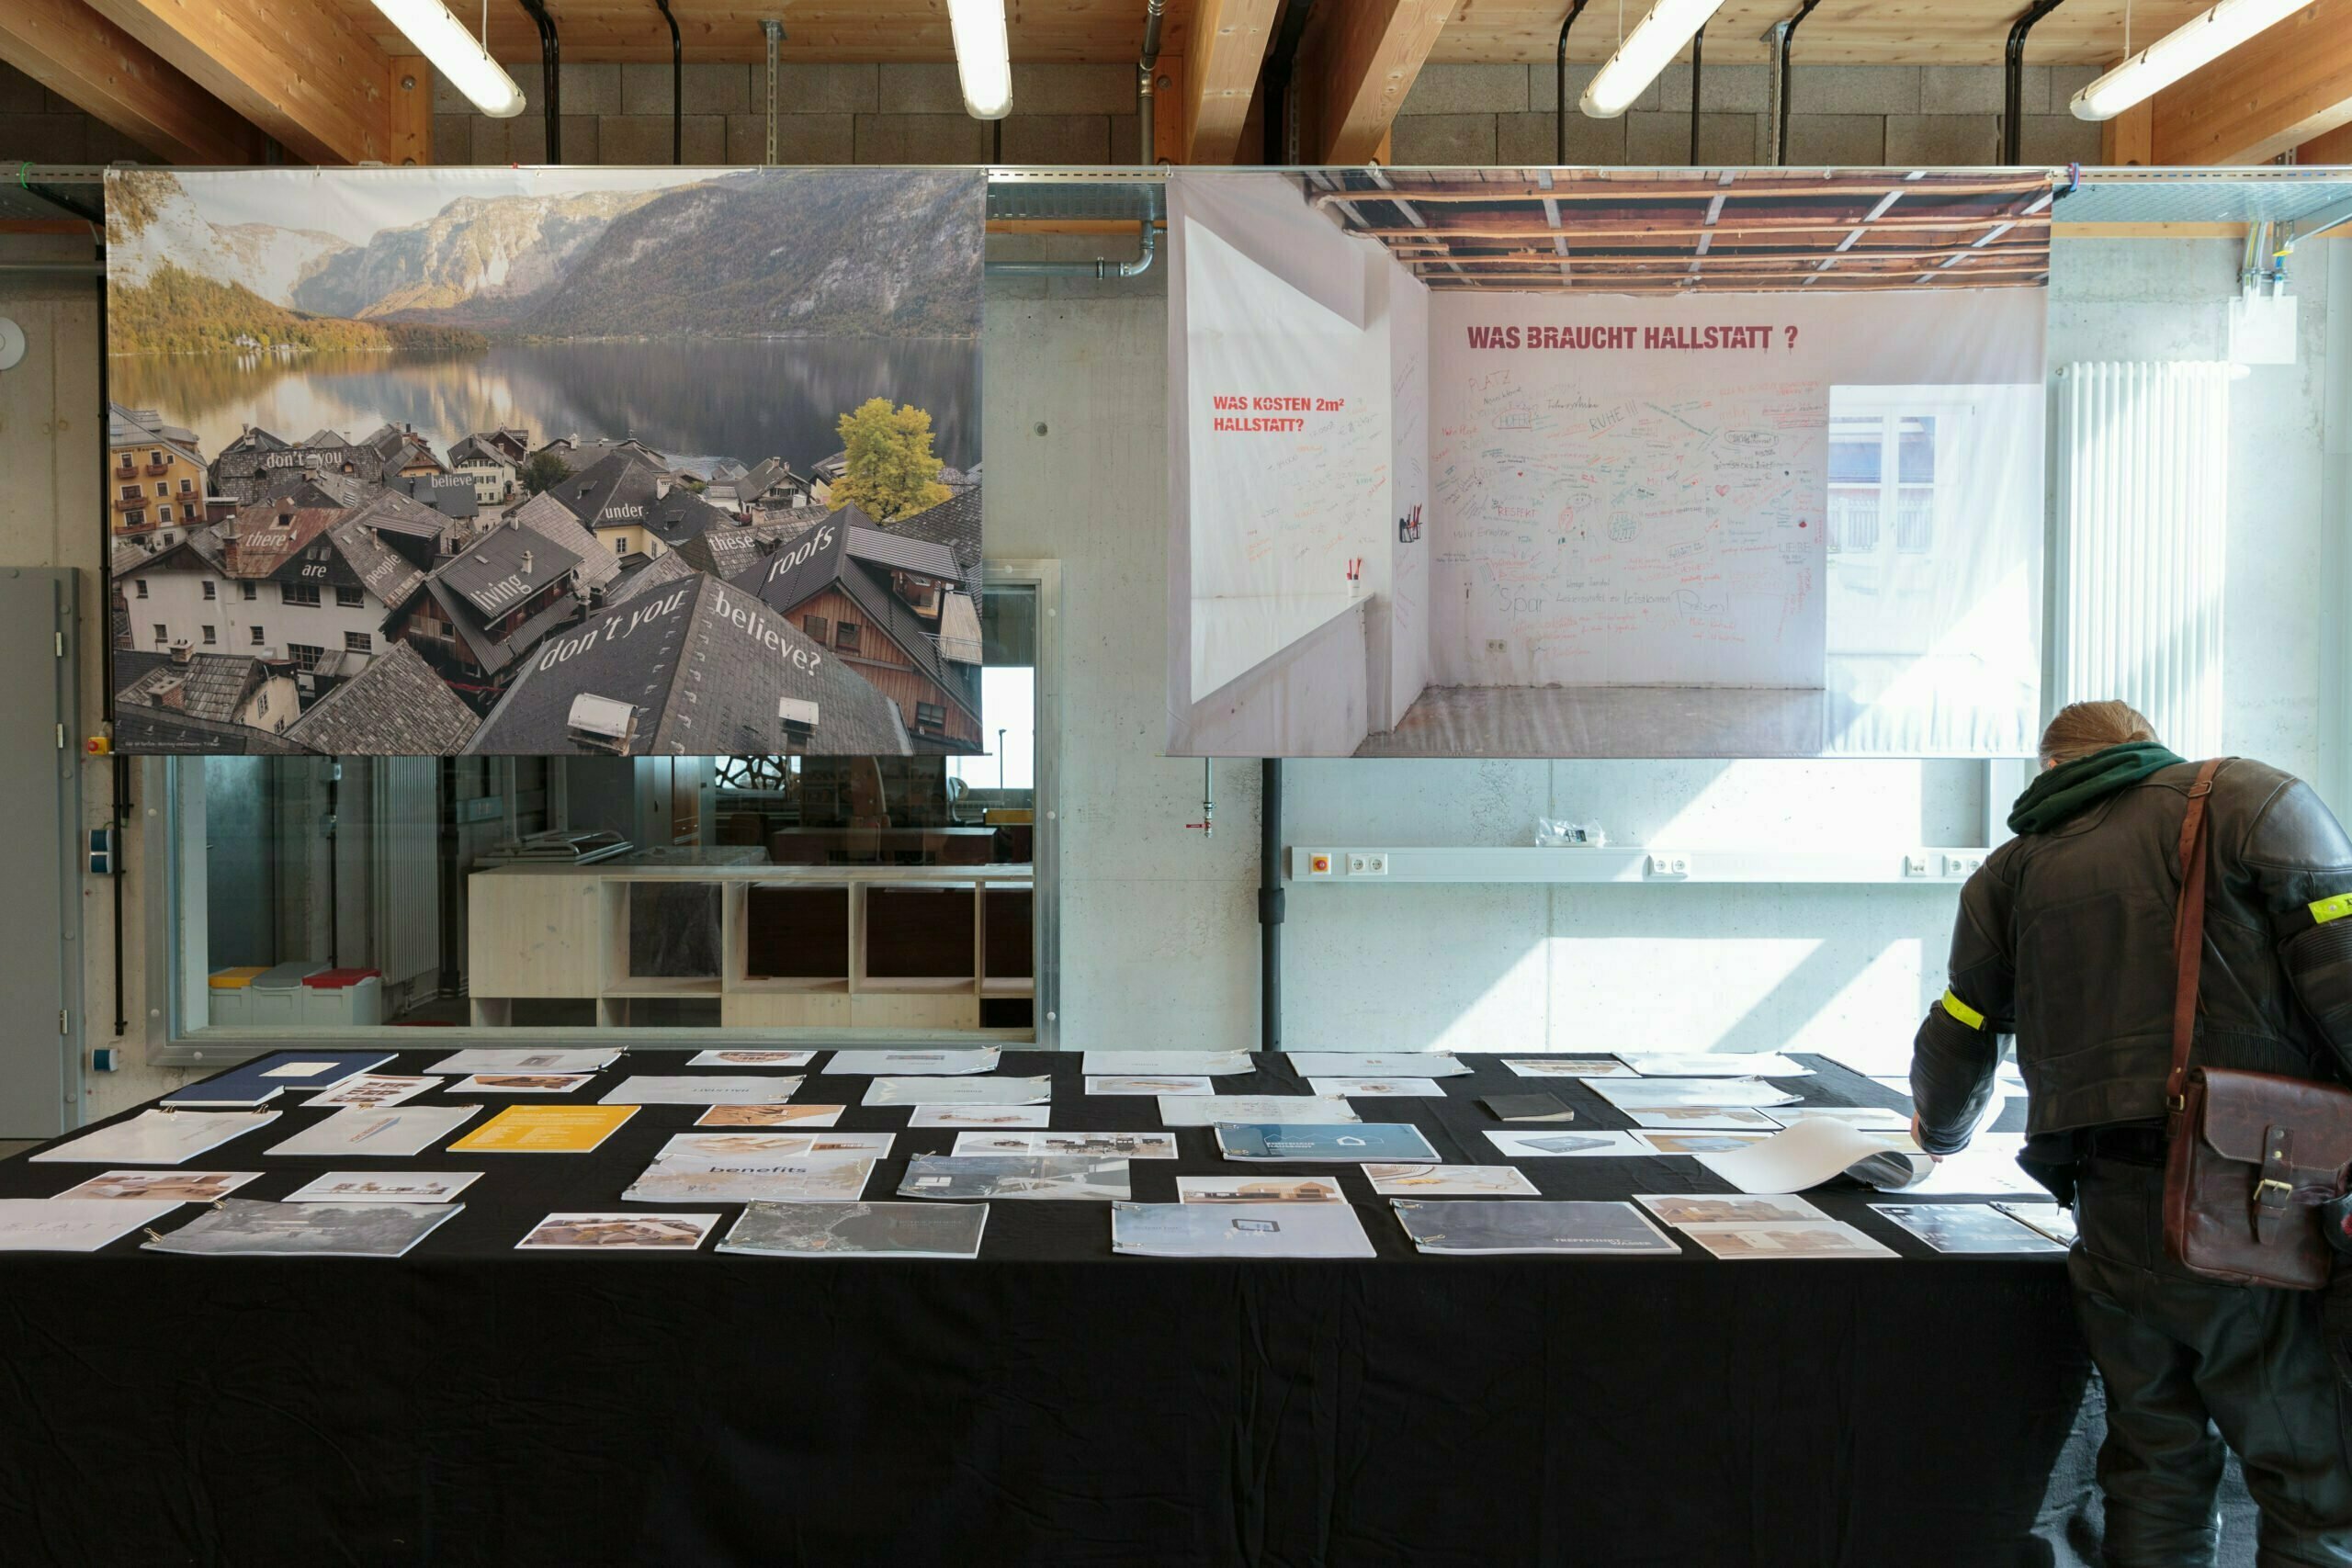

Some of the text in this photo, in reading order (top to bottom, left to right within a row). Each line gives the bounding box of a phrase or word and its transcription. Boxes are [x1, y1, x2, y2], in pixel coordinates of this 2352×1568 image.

[1467, 325, 1798, 349] WAS BRAUCHT HALLSTATT ?
[1213, 396, 1248, 411] WAS
[1253, 397, 1311, 412] KOSTEN
[1213, 417, 1305, 432] HALLSTATT?
[1589, 406, 1624, 433] RUHE
[266, 449, 342, 469] don't you
[431, 473, 472, 489] believe
[605, 503, 643, 520] under
[245, 532, 287, 548] there
[708, 533, 754, 551] these
[768, 525, 836, 583] roofs
[301, 563, 327, 579] are
[368, 553, 401, 587] people
[470, 573, 532, 610] living
[1499, 588, 1544, 621] Spar
[539, 591, 821, 677] don't you believe?
